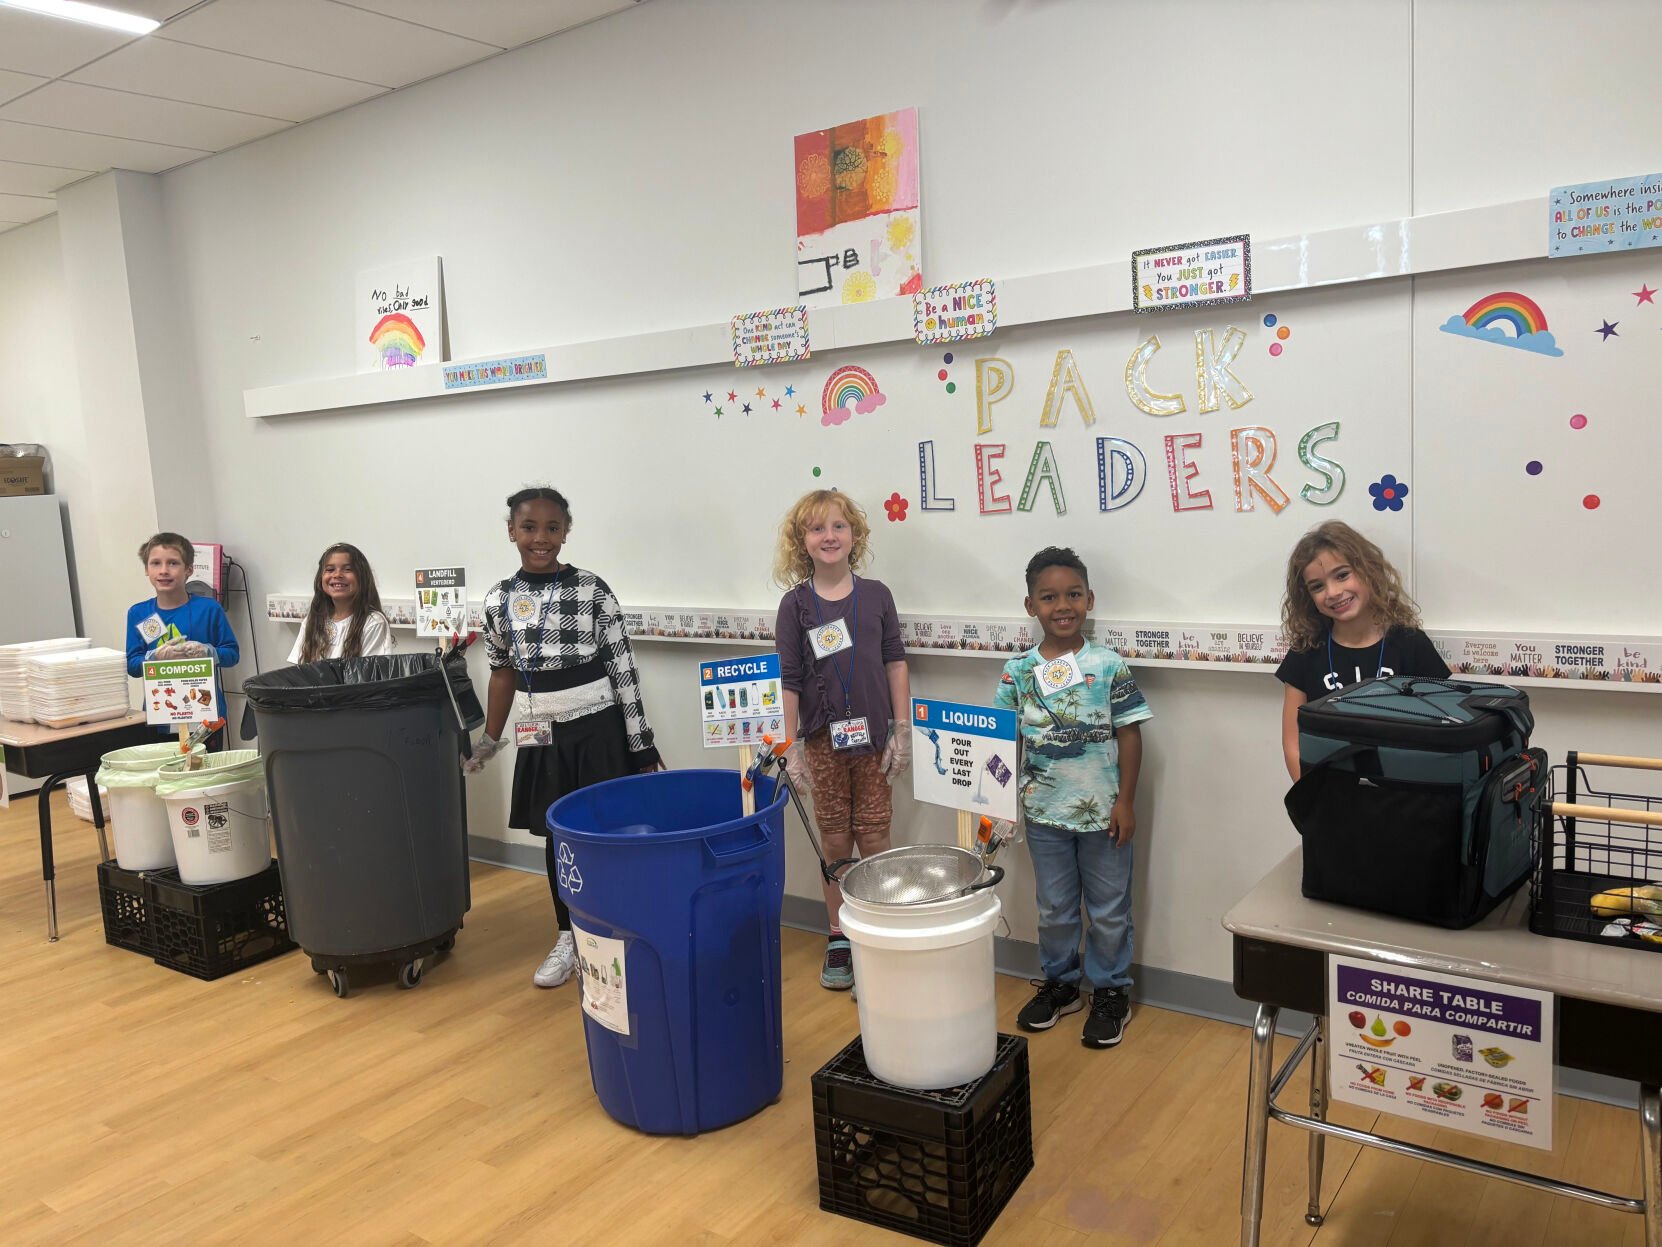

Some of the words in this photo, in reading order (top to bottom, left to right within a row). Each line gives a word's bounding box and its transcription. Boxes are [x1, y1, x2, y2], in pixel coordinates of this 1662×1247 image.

[1570, 185, 1635, 205] Somewhere
[1640, 180, 1662, 195] insi
[1555, 210, 1573, 223] ALL
[1576, 208, 1592, 220] OF
[1595, 205, 1610, 218] US
[1613, 208, 1621, 217] is
[1626, 202, 1643, 215] the
[1556, 229, 1567, 240] to
[1571, 223, 1615, 238] CHANGE
[1620, 220, 1637, 233] the
[1143, 261, 1150, 270] It
[1154, 256, 1183, 268] NEVER
[1186, 252, 1200, 267] got
[1157, 272, 1173, 284] You
[1177, 267, 1203, 281] JUST
[1207, 263, 1223, 280] got
[395, 283, 410, 298] bad
[1156, 281, 1227, 301] STRONGER.
[924, 302, 938, 315] Be
[941, 304, 948, 313] a
[952, 293, 984, 312] NICE
[755, 322, 773, 332] KIND
[774, 321, 783, 330] act
[938, 313, 985, 330] human
[742, 334, 769, 344] CHANGE
[751, 343, 775, 353] WHOLE
[777, 341, 791, 350] DAY
[975, 325, 1254, 435] PACK
[918, 421, 1346, 515] LEADERS
[429, 569, 456, 578] LANDFILL
[1108, 629, 1123, 637] You
[1135, 630, 1170, 639] STRONGER
[1182, 632, 1195, 641] be
[1237, 633, 1264, 643] BELIEVE
[1105, 637, 1128, 647] MATTER
[1136, 639, 1170, 648] TOGETHER
[1178, 640, 1199, 649] kind
[1465, 641, 1496, 650] Everyone
[1515, 643, 1536, 652] You
[1555, 645, 1604, 656] STRONGER
[1624, 647, 1641, 658] be
[1510, 653, 1542, 664] MATTER
[1555, 656, 1604, 667] TOGETHER
[1617, 657, 1647, 668] kind
[160, 664, 207, 675] COMPOST
[705, 669, 711, 678] 2
[717, 661, 768, 678] RECYCLE
[918, 706, 924, 718] 1
[942, 710, 997, 730] LIQUIDS
[951, 737, 972, 748] POUR
[954, 748, 969, 757] OUT
[950, 757, 973, 768] EVERY
[952, 768, 971, 777] LAST
[952, 778, 972, 788] DROP
[1370, 979, 1434, 1002] SHARE
[1439, 991, 1503, 1015] TABLE
[1346, 991, 1400, 1010] COMIDA
[1403, 1002, 1441, 1018] PARA
[1445, 1010, 1533, 1036] COMPARTIR
